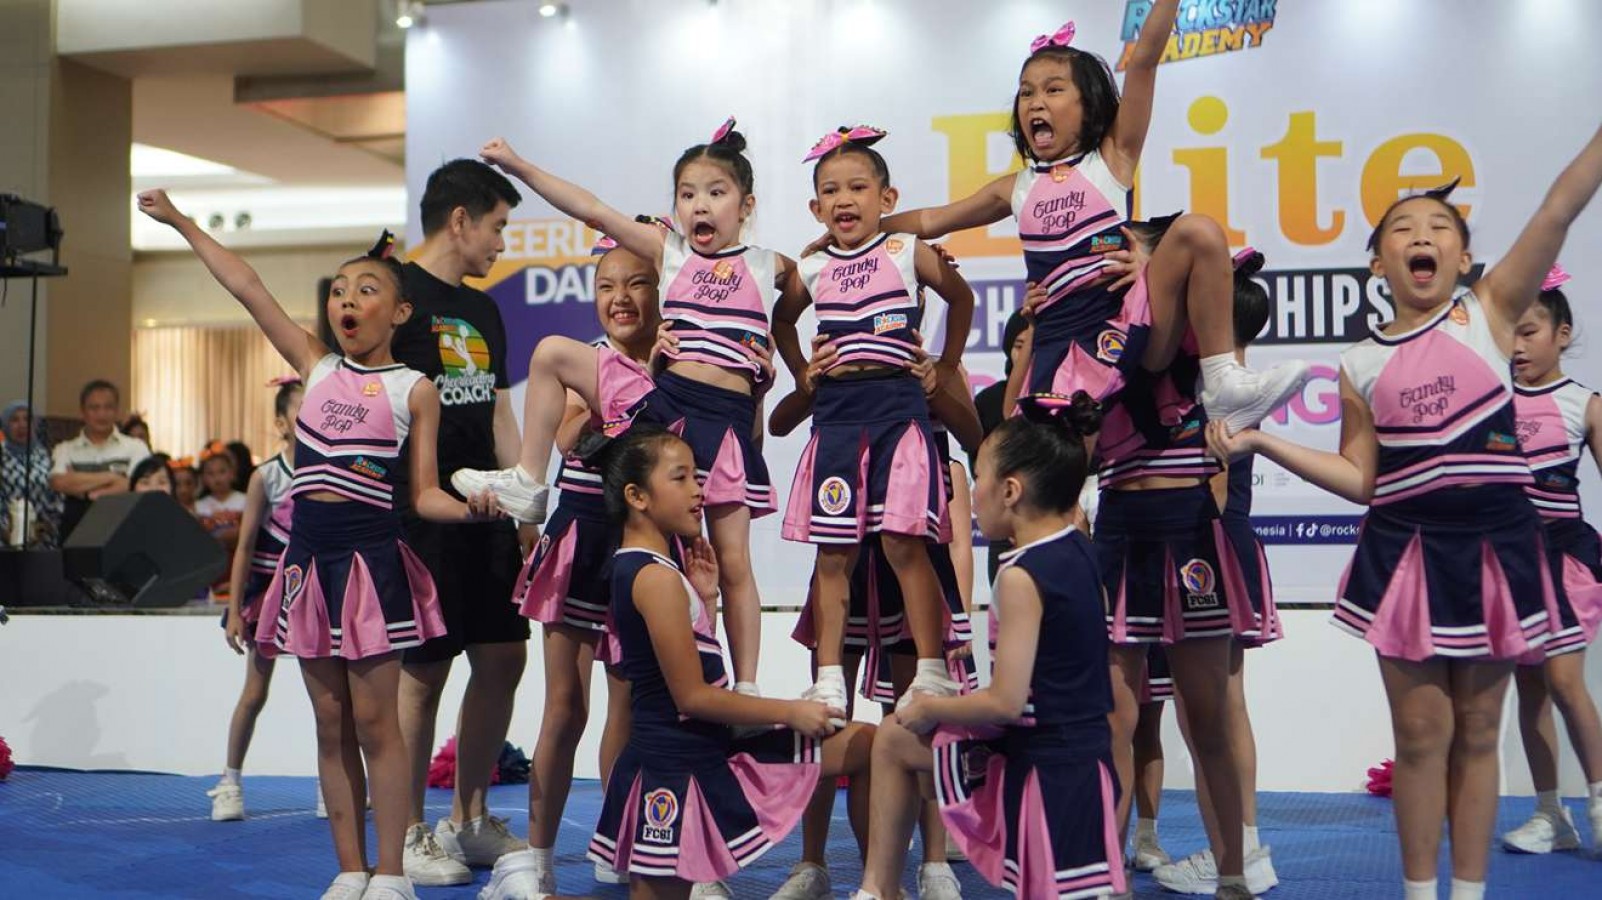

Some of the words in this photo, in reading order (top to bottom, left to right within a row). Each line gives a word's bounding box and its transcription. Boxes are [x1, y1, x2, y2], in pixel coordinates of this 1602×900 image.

[1120, 0, 1277, 41] RCKSTAR
[1115, 22, 1272, 72] ADEMY
[931, 96, 1476, 258] Eite
[1033, 191, 1087, 219] Candy
[1041, 210, 1076, 234] Pop
[832, 257, 879, 282] Candy
[693, 284, 729, 303] Pop
[840, 274, 870, 293] Pop
[434, 373, 496, 389] Cheerleading
[1399, 375, 1456, 409] Candy
[440, 385, 491, 406] COACH
[321, 398, 370, 424] Candy
[1412, 397, 1449, 424] Pop
[320, 414, 353, 434] Pop
[645, 827, 671, 841] FCSI
